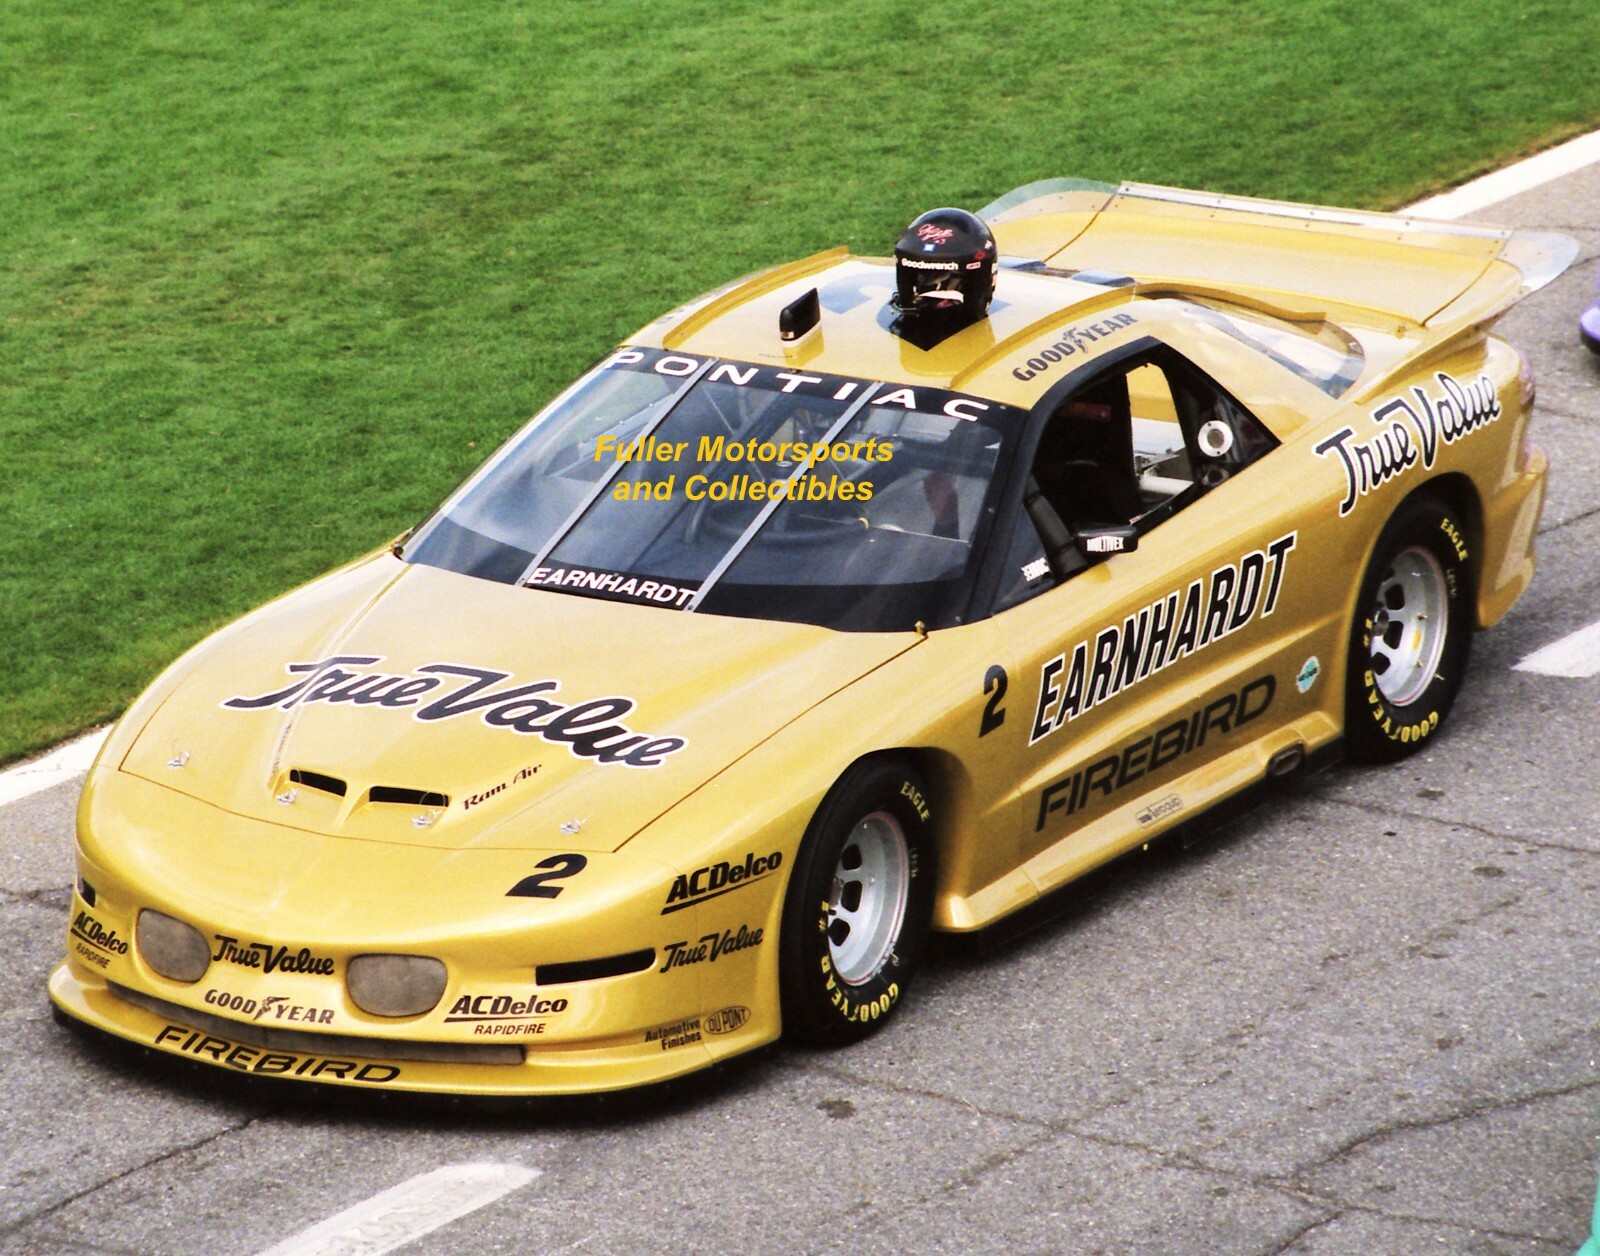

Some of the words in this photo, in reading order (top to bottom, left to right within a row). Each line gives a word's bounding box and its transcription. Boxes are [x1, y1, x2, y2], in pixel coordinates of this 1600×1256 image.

[604, 351, 989, 421] PONTIAC
[1440, 518, 1468, 561] EAGLE
[527, 567, 698, 606] EARNHARDT
[1028, 530, 1298, 747] EARNHARDT
[979, 665, 1008, 738] 2
[1036, 674, 1277, 832] FIREBIRD
[461, 784, 507, 810] Ram
[513, 764, 542, 784] Air
[900, 781, 930, 822] EAGLE
[505, 853, 588, 899] 2
[663, 851, 783, 908] ACDelco
[72, 911, 128, 955] ACDelco
[447, 995, 568, 1016] ACDelco
[474, 1023, 546, 1035] RAPIDFIRE
[645, 1019, 700, 1042] Automotive
[661, 1032, 701, 1050] Finishes
[155, 1025, 401, 1083] FIREBIRD
